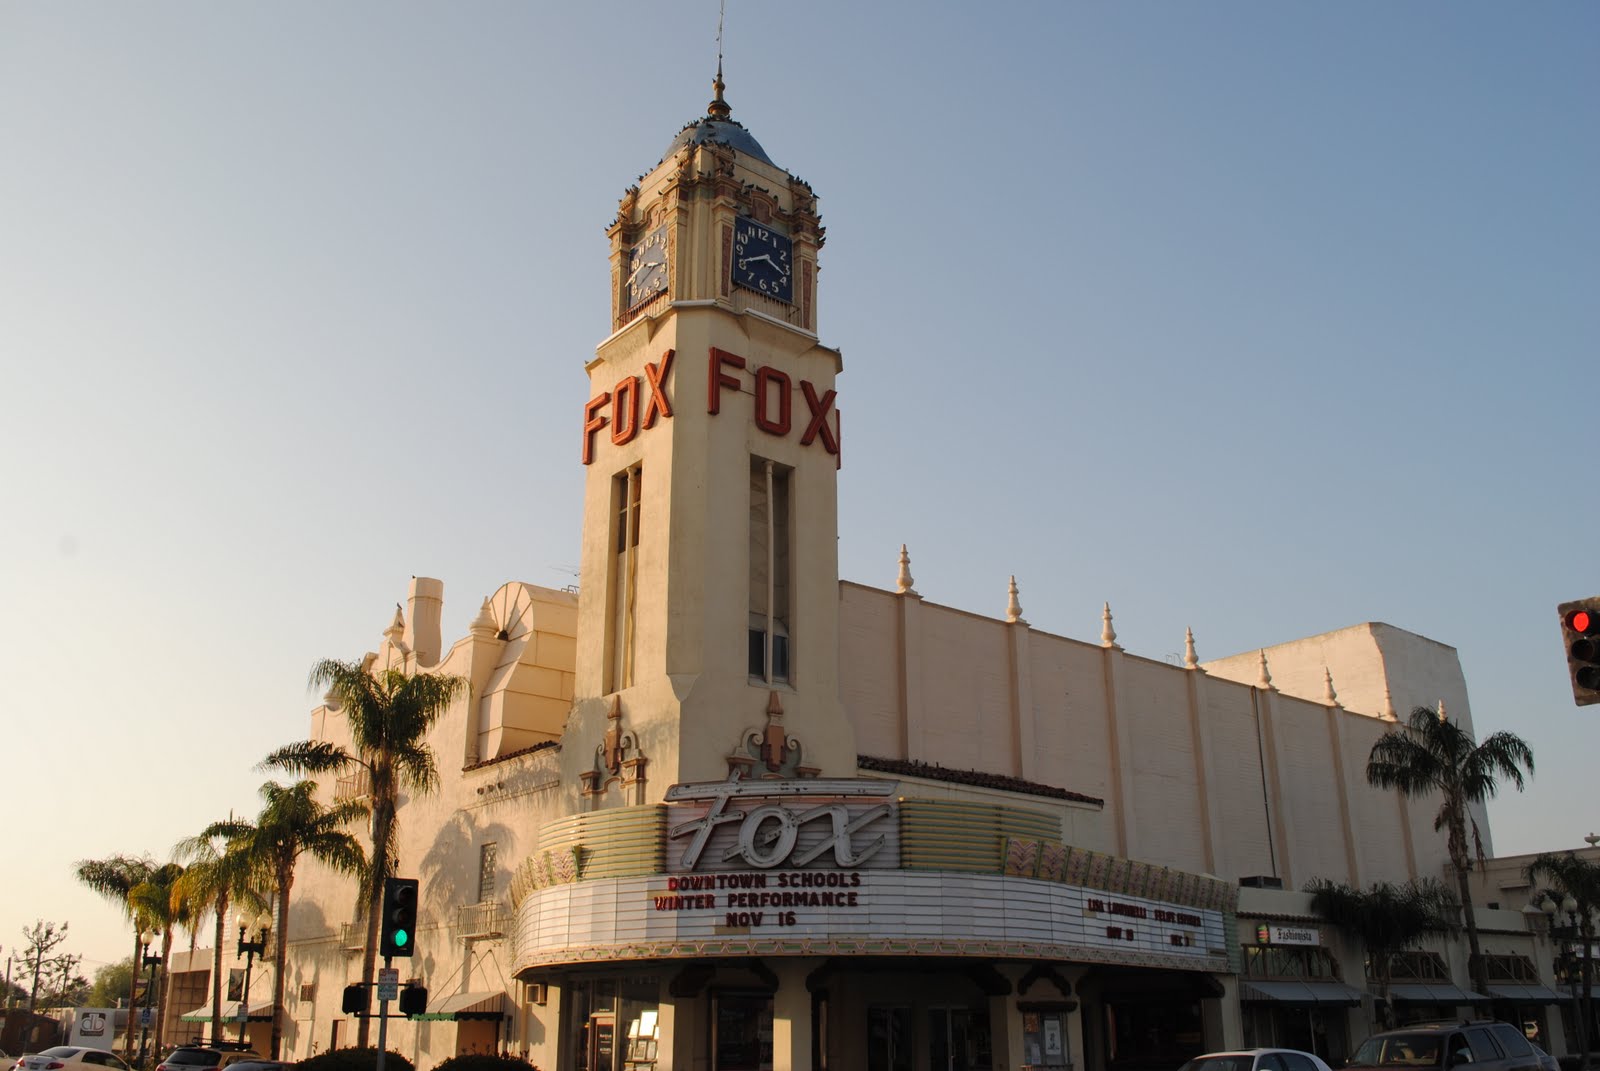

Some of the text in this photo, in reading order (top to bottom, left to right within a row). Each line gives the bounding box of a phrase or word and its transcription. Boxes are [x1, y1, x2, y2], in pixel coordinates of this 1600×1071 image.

[737, 231, 748, 245] 10
[748, 226, 755, 238] 11
[758, 228, 769, 241] 12
[646, 236, 654, 248] 12
[661, 238, 666, 250] 2
[773, 237, 777, 248] 1
[639, 244, 645, 256] 11
[736, 244, 744, 255] 9
[780, 250, 787, 260] 2
[739, 258, 747, 270] 8
[783, 264, 790, 275] 3
[748, 271, 755, 281] 7
[780, 276, 787, 287] 4
[654, 278, 660, 288] 5
[759, 278, 767, 290] 6
[771, 281, 779, 293] 5
[707, 346, 838, 455] FOX
[582, 349, 675, 465] FOX
[668, 872, 861, 891] DOWNTOWN SCHOOLS
[654, 891, 858, 911] WINTER PERFORMANCE
[726, 911, 796, 927] NOV 16
[1276, 928, 1312, 942] Fashionista
